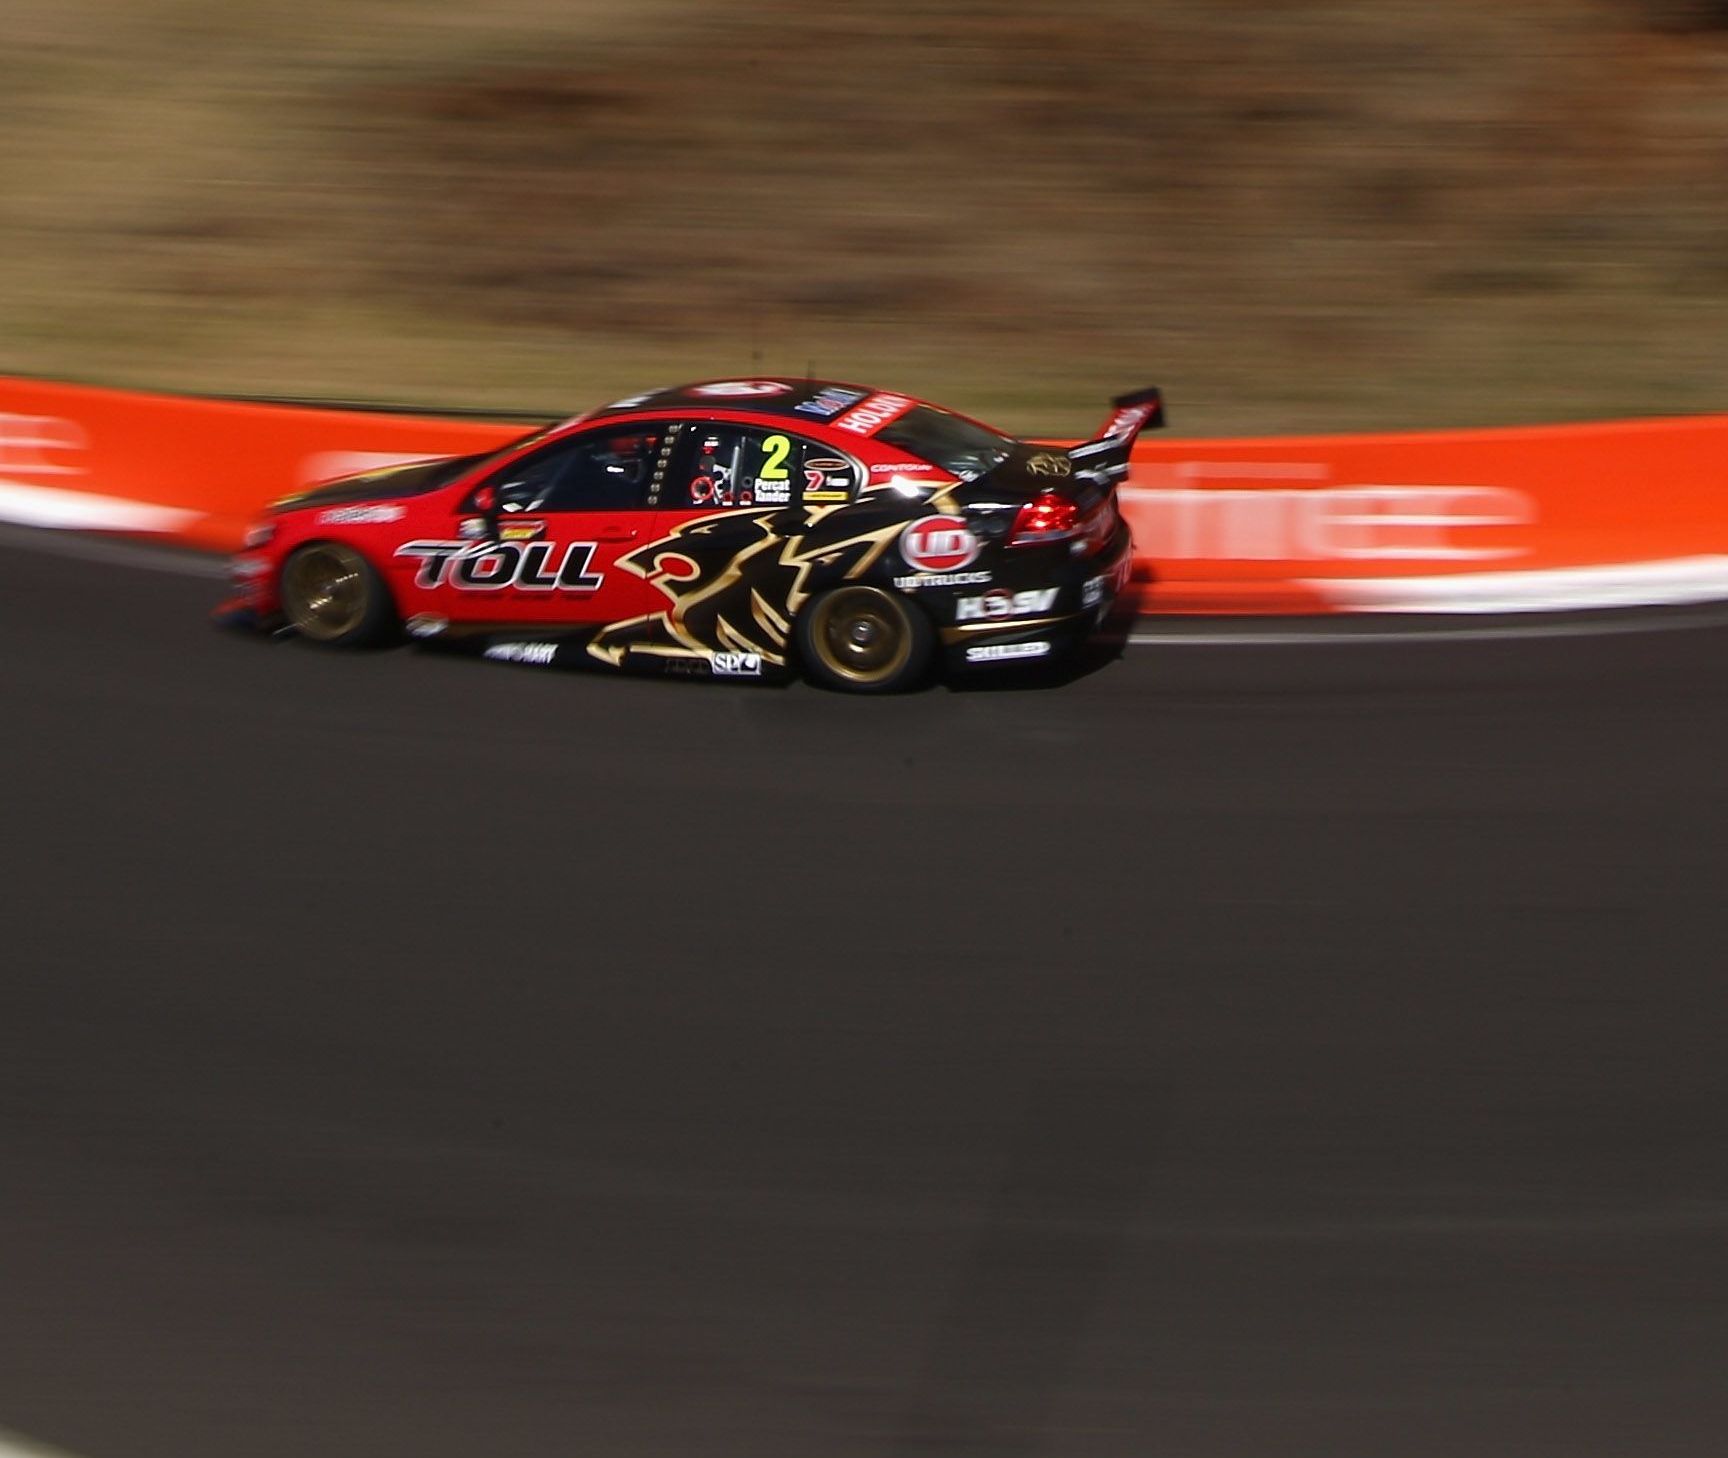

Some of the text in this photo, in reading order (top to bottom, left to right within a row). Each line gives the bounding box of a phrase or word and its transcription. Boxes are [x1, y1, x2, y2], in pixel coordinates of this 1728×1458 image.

[760, 434, 791, 479] 2
[755, 478, 791, 491] Percat
[755, 490, 791, 502] Tander
[909, 528, 971, 558] UD
[393, 540, 605, 591] TOLL
